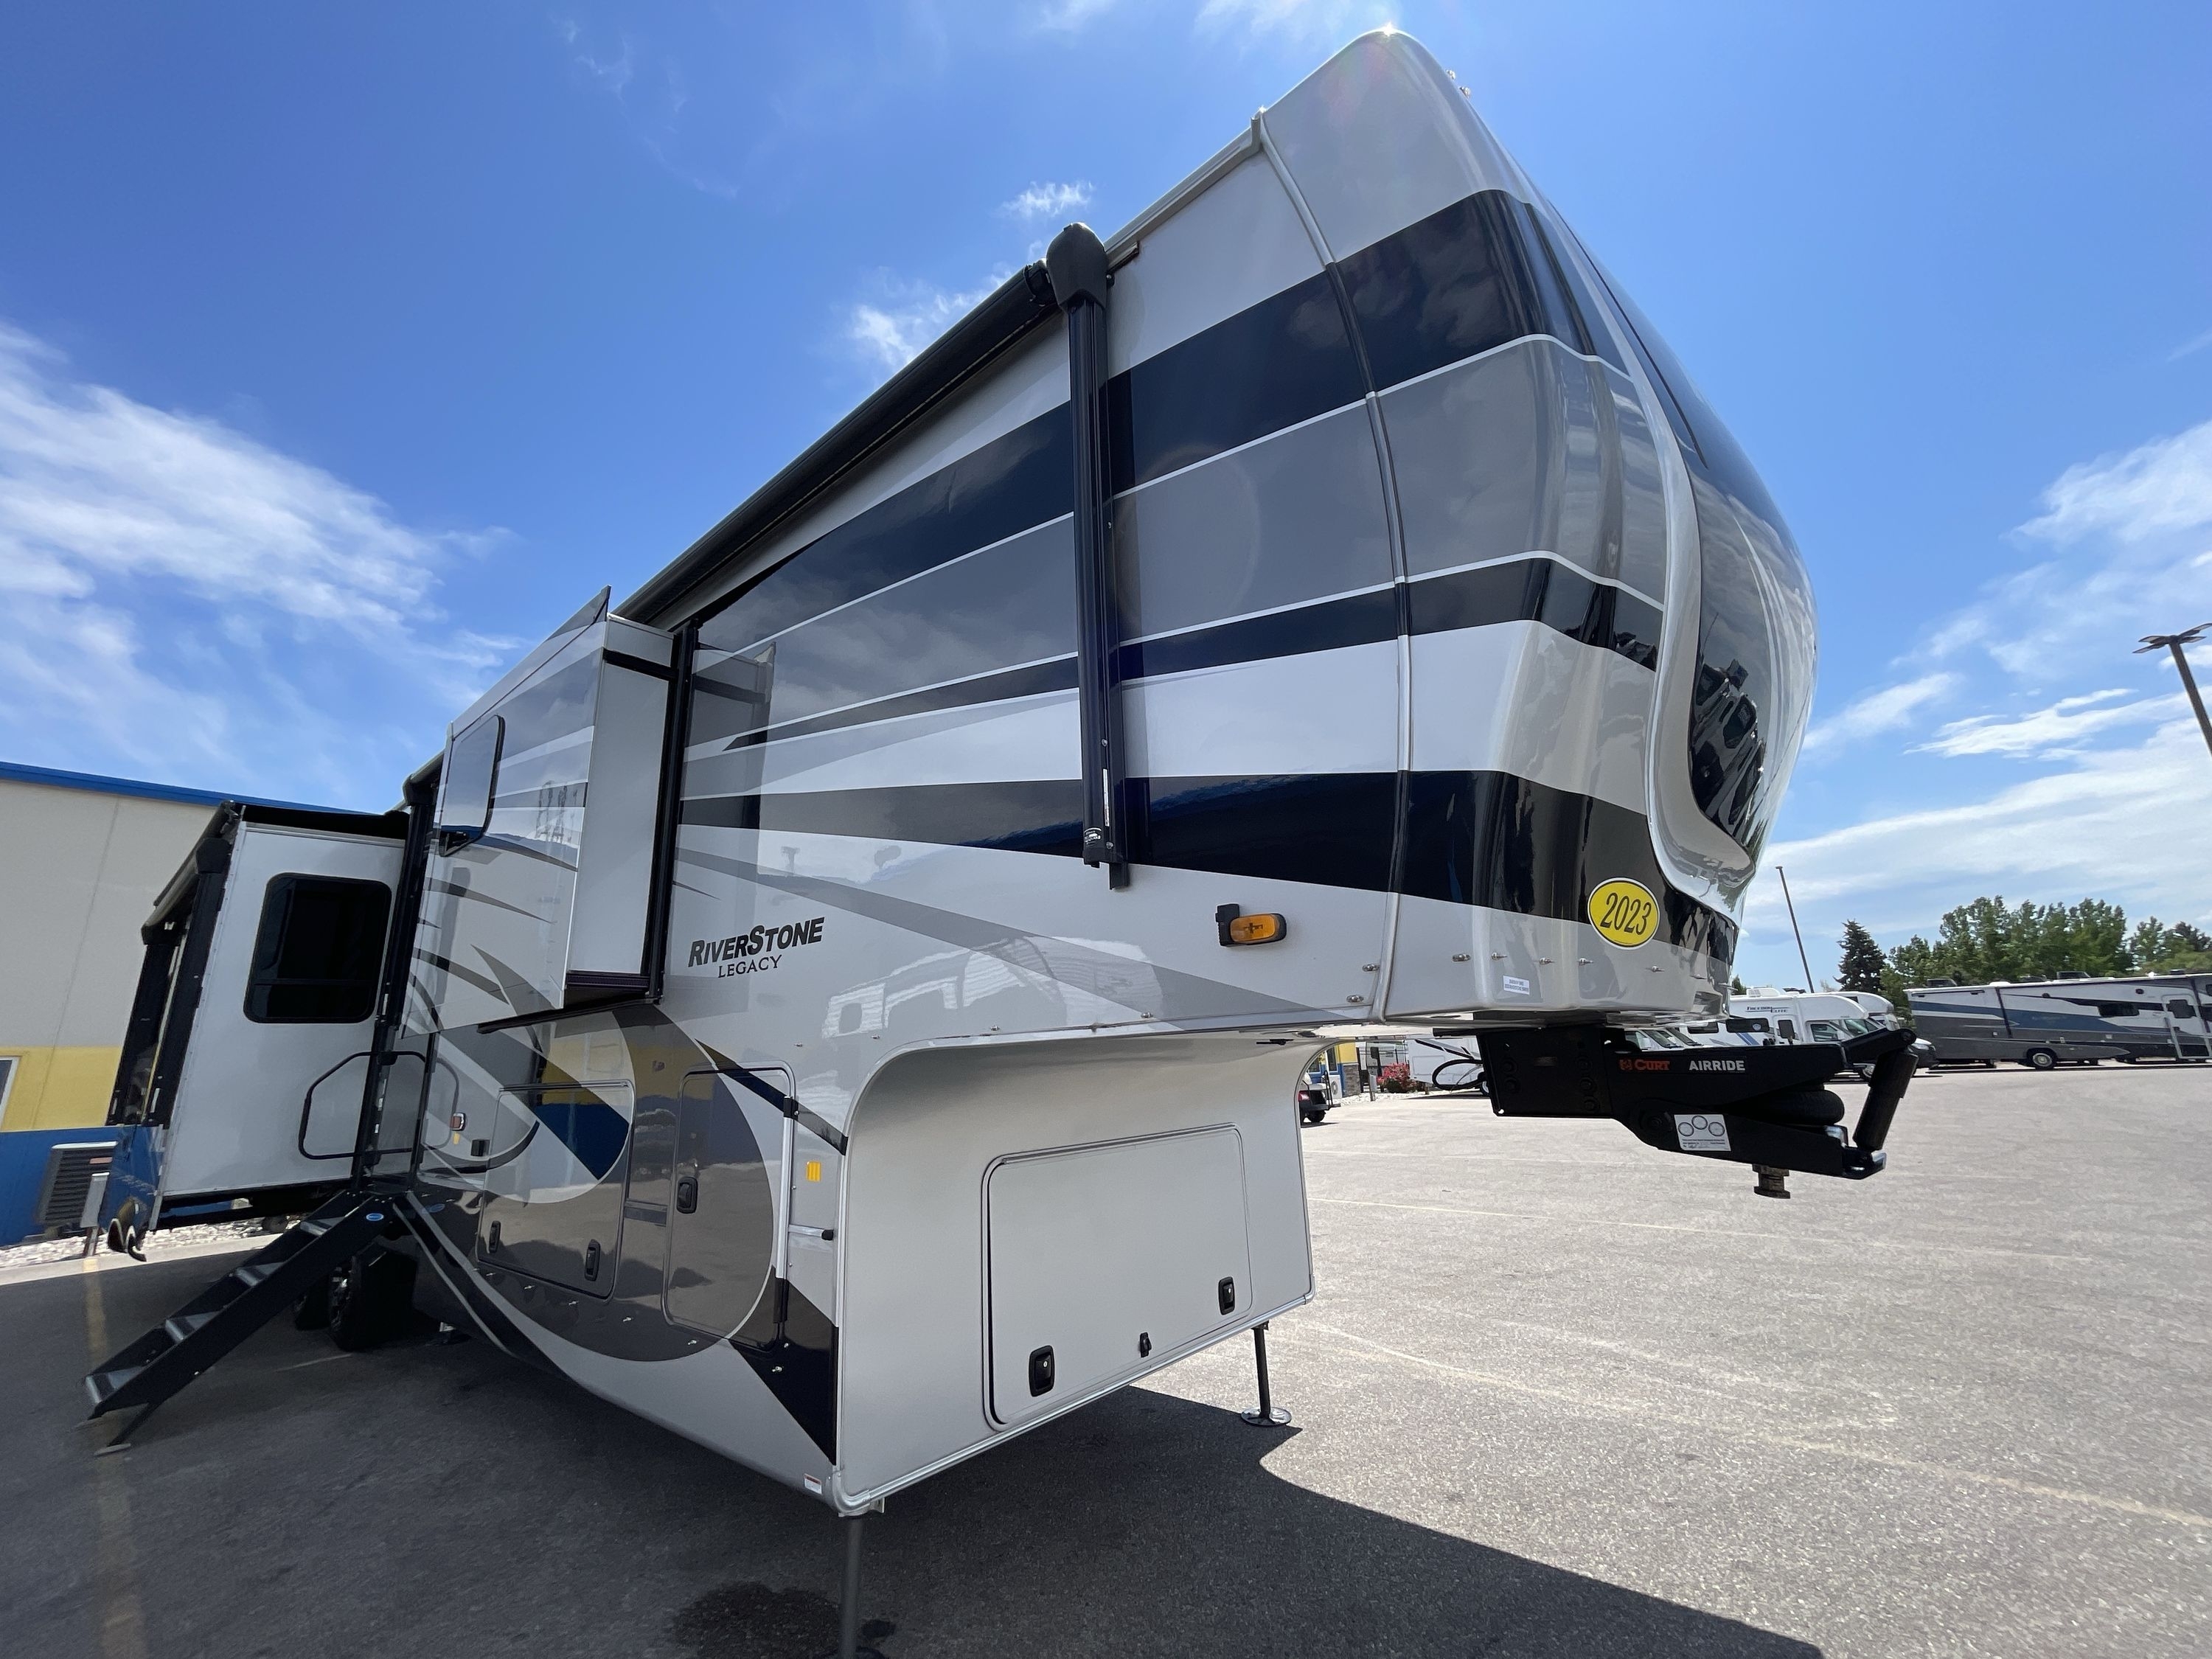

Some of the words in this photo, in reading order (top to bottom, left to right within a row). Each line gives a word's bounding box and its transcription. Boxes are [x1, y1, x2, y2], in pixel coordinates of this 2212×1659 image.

[1599, 892, 1652, 935] 2023
[688, 917, 824, 967] RIVERSTONE
[718, 954, 782, 978] LEGACY
[1635, 1059, 1670, 1071] CURT
[1688, 1060, 1745, 1071] AIRRIDE
